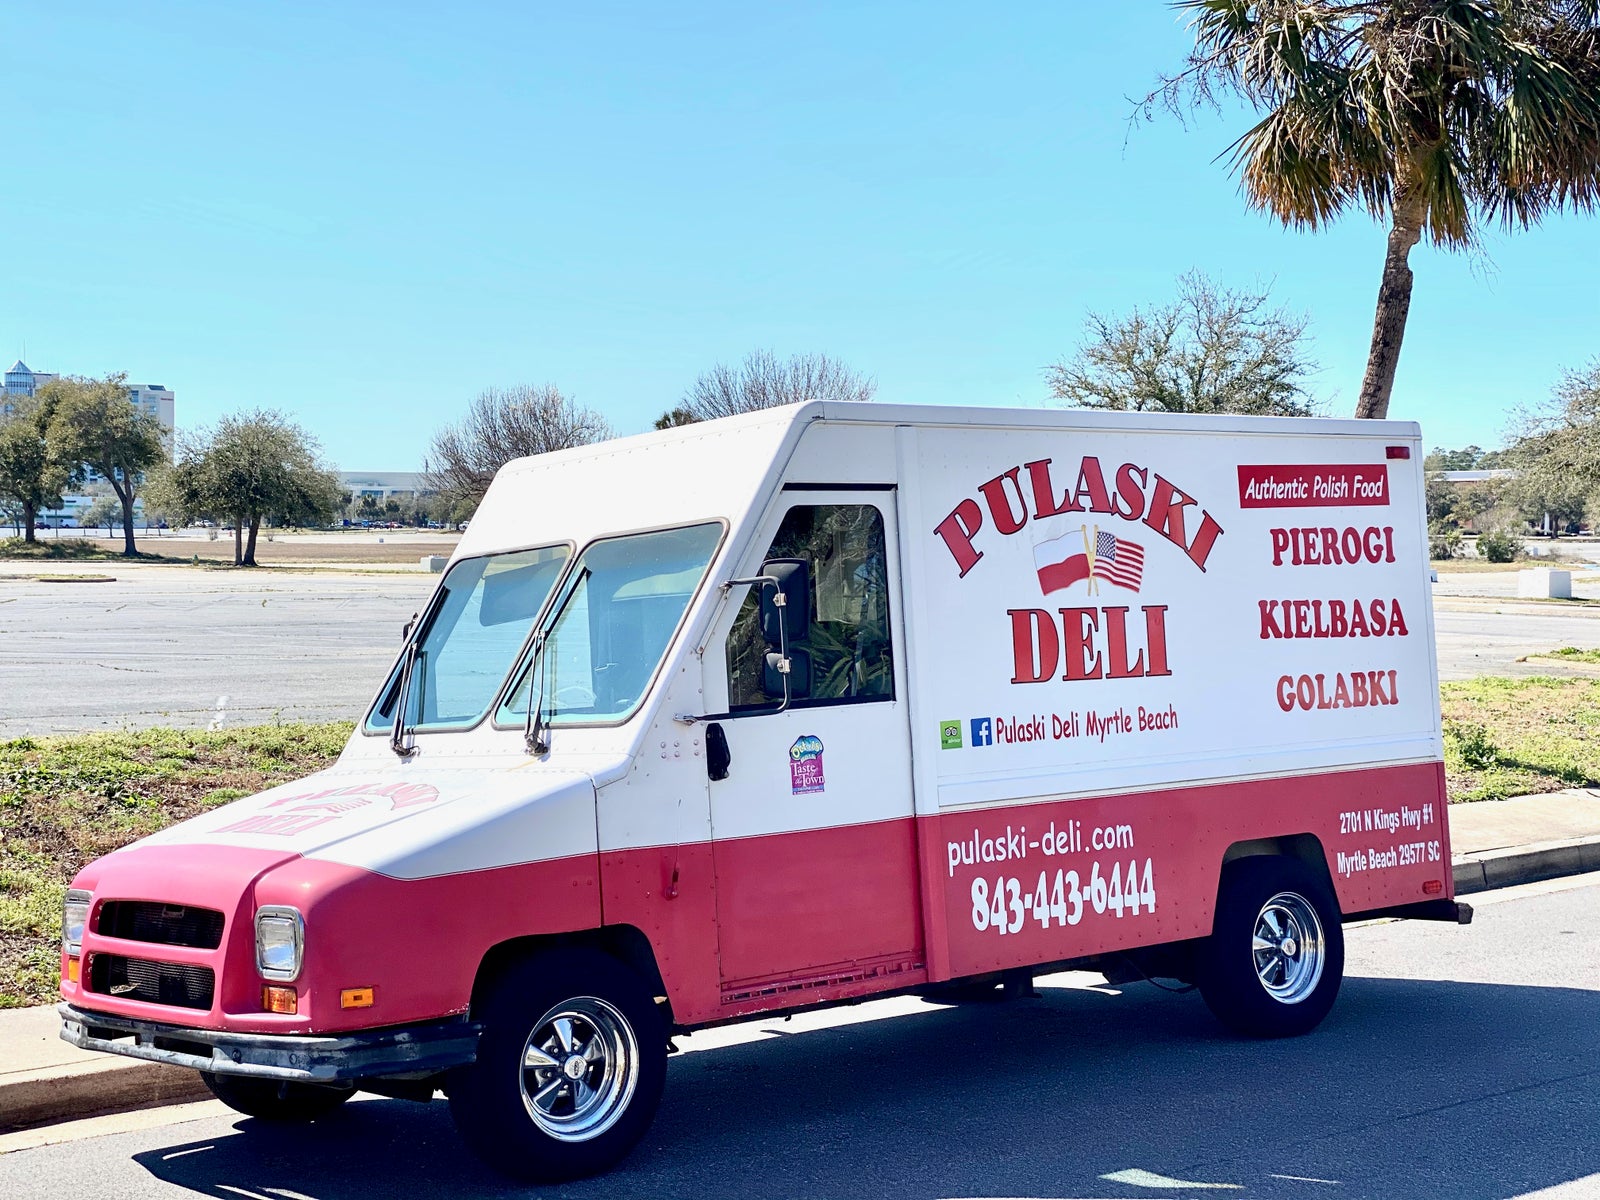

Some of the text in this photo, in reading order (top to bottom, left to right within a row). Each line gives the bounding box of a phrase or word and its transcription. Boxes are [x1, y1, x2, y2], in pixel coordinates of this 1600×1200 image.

[1245, 474, 1384, 500] Authentic Polish Food
[933, 456, 1225, 579] PULASKI
[1270, 526, 1395, 566] PIEROGI
[1258, 598, 1408, 639] KIELBASA
[1007, 605, 1172, 684] DELI
[1276, 670, 1399, 712] GOLABKI
[996, 703, 1178, 744] Pulaski Deli Myrtle Beach
[790, 762, 816, 776] Taste
[797, 773, 824, 787] Town
[1340, 803, 1433, 834] 2701 N Kings Hwy #1
[947, 819, 1134, 877] pulaski-deli.com
[1337, 840, 1440, 878] Myrtle Beach 29577 SC
[971, 857, 1156, 935] 843-443-6444
